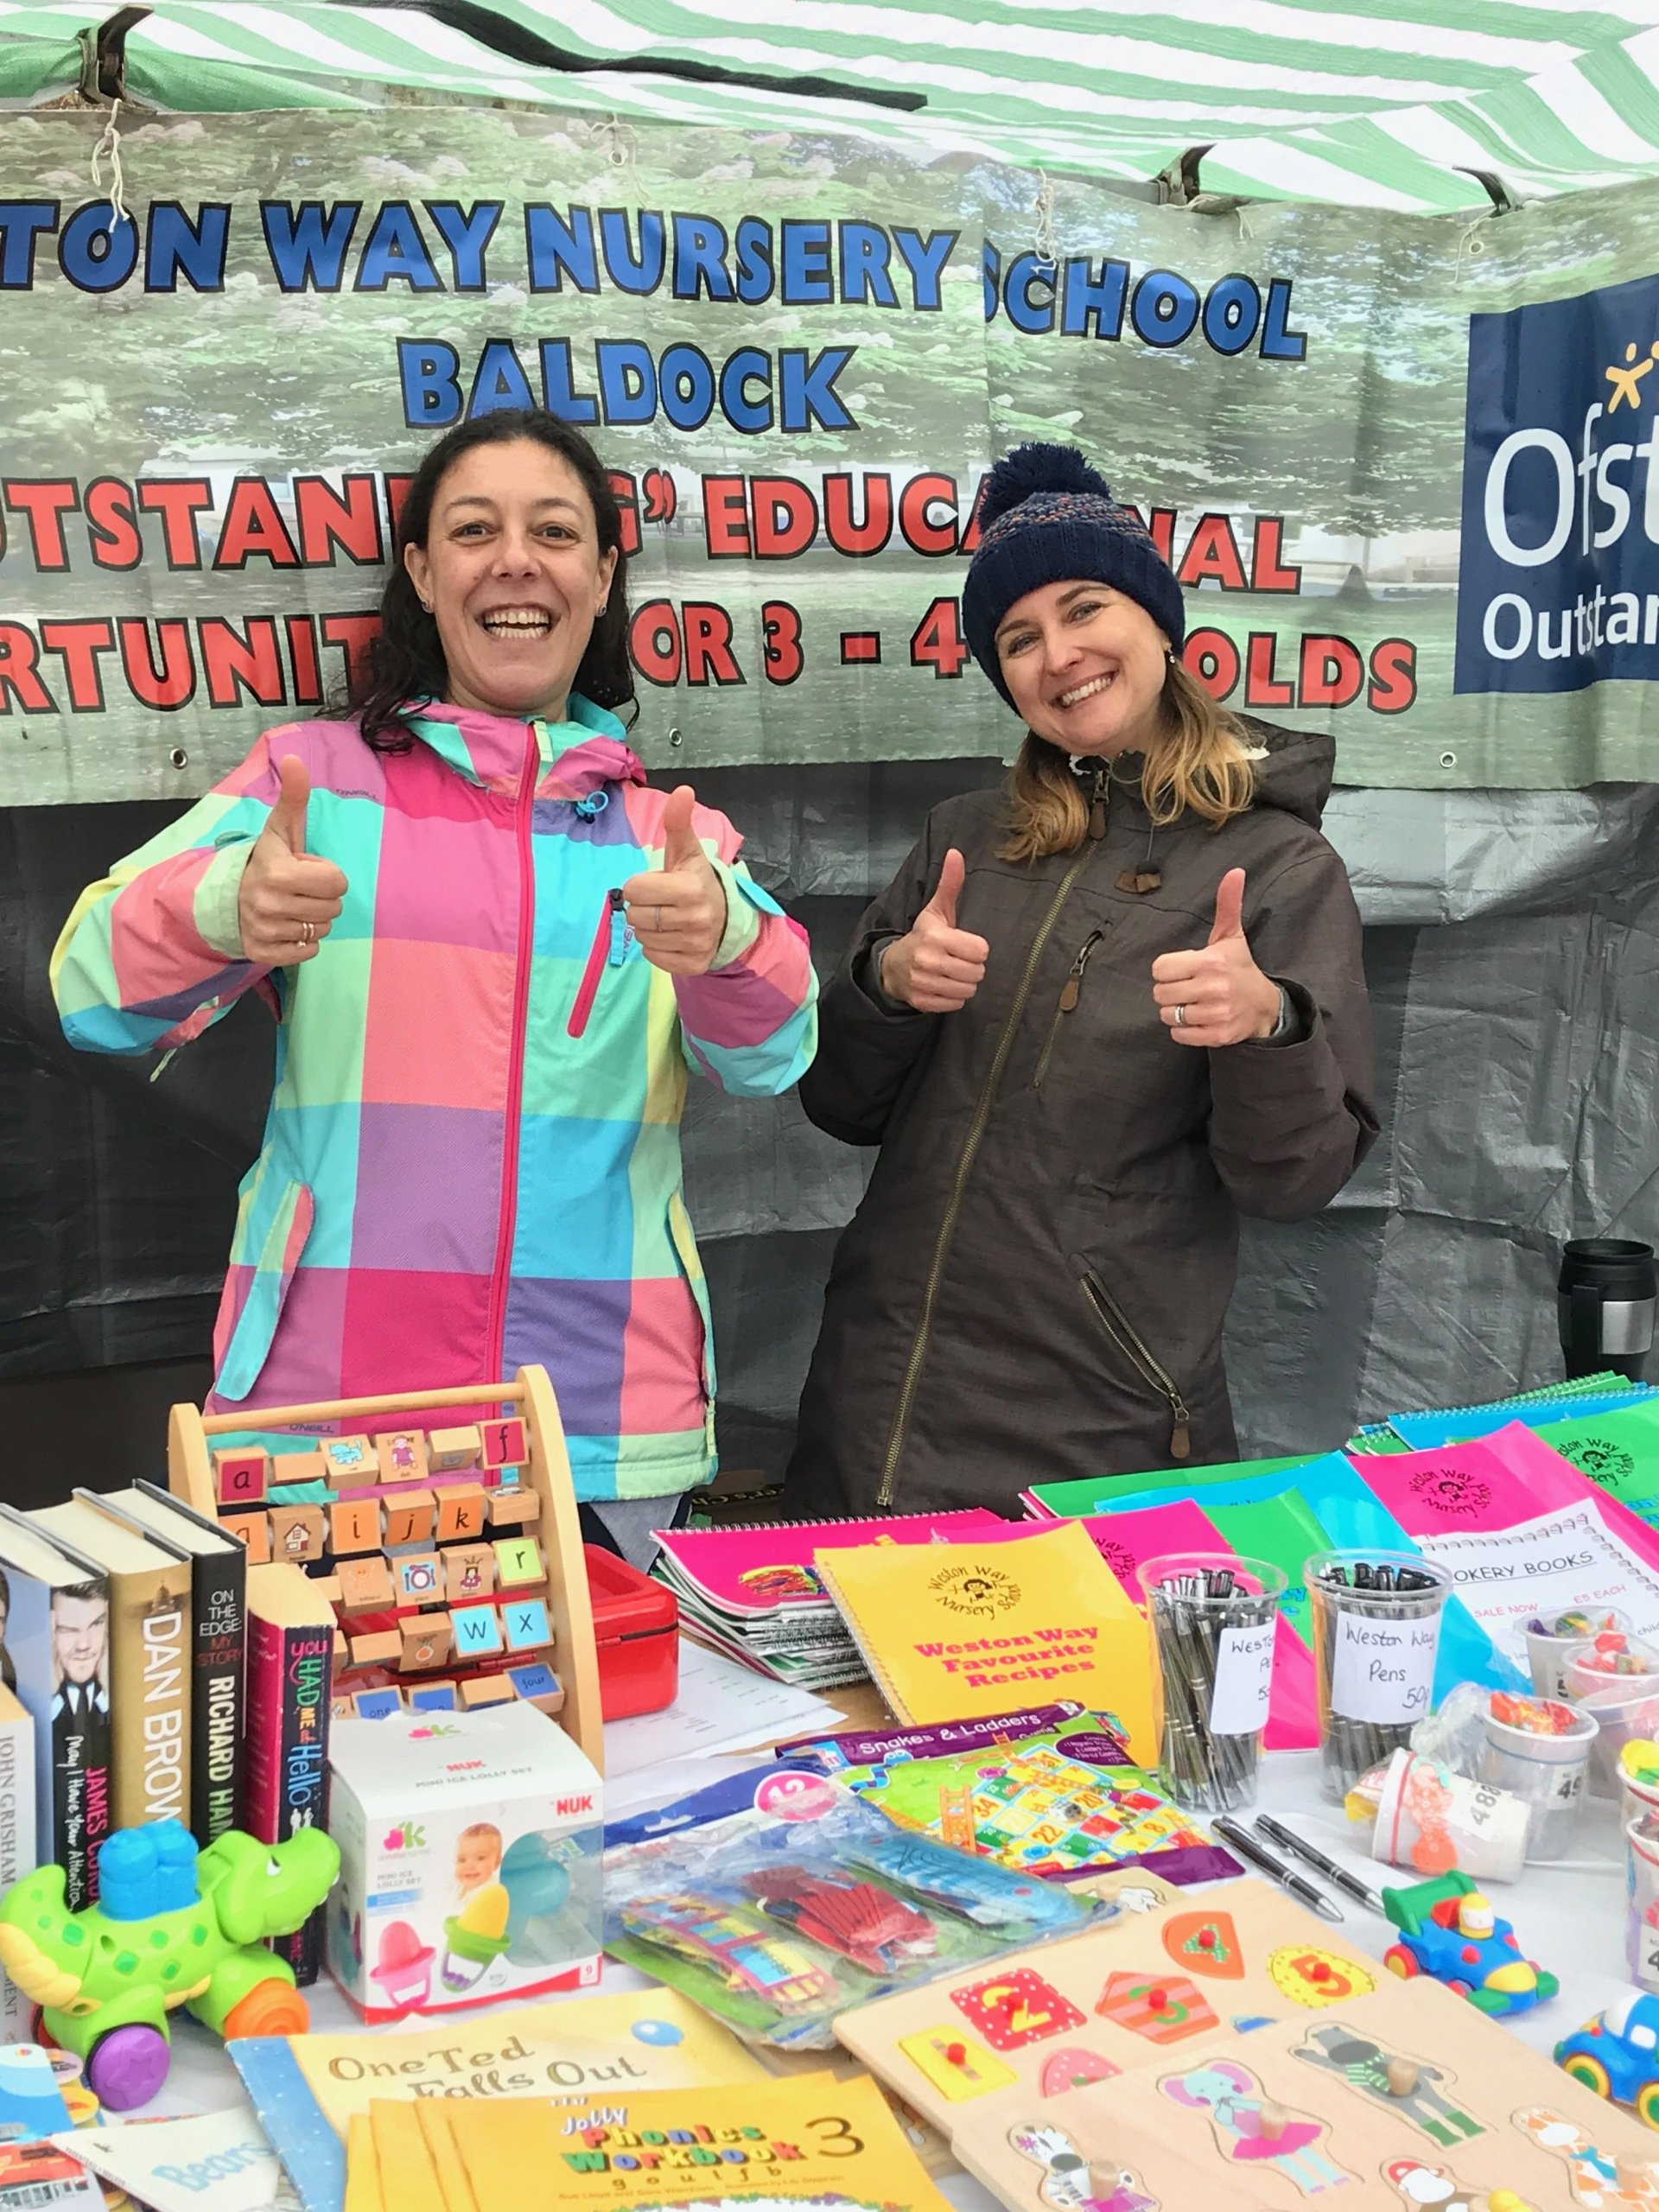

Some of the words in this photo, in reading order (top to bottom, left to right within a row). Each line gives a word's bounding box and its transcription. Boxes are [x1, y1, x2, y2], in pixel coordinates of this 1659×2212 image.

[259, 199, 505, 294] WAY
[524, 201, 961, 312] NURSERY
[397, 337, 861, 434] BALDOCK
[763, 600, 804, 686] 3
[910, 597, 971, 679] 4
[1183, 629, 1418, 715] OLDS
[499, 1425, 508, 1464] f
[233, 1471, 251, 1491] a
[353, 1514, 360, 1539] i
[402, 1513, 415, 1541] j
[455, 1507, 470, 1531] k
[516, 1550, 526, 1570] r
[1523, 1550, 1593, 1575] BOOKS
[928, 1566, 969, 1592] Weston
[975, 1565, 1010, 1582] Way
[211, 1589, 234, 1605] ON
[935, 1595, 995, 1621] Nursery
[1474, 1606, 1504, 1618] SALE
[1508, 1603, 1539, 1614] NOW
[1593, 1585, 1626, 1599] EACH
[207, 1604, 237, 1621] THE
[913, 1635, 1034, 1659] Weston
[1033, 1626, 1098, 1643] Way
[1346, 1621, 1403, 1647] Weston
[143, 1611, 182, 1703] DAN
[941, 1643, 1096, 1674] Favourite
[1370, 1659, 1407, 1682] Pens
[296, 1658, 322, 1707] HAD
[521, 1675, 546, 1690] four
[964, 1660, 1096, 1688] Recipes
[208, 1675, 236, 1783] RICHARD
[299, 1707, 316, 1730] ME
[859, 1732, 935, 1756] Snakes
[939, 1726, 956, 1741] &
[959, 1712, 1042, 1737] Ladders
[287, 1744, 323, 1806] Hello
[67, 1778, 85, 1814] Have
[85, 1766, 109, 1835] JAMES
[556, 1795, 594, 1816] NUK
[1031, 1825, 1064, 1845] 22
[982, 1985, 1052, 2034] 2
[328, 2056, 427, 2082] One
[427, 2036, 536, 2075] Ted
[408, 2069, 536, 2100] Falls
[546, 2056, 647, 2087] Out
[561, 2107, 627, 2136] Jolly
[562, 2140, 808, 2175] Workbook
[804, 2115, 866, 2158] 3
[581, 2123, 766, 2150] Phonics
